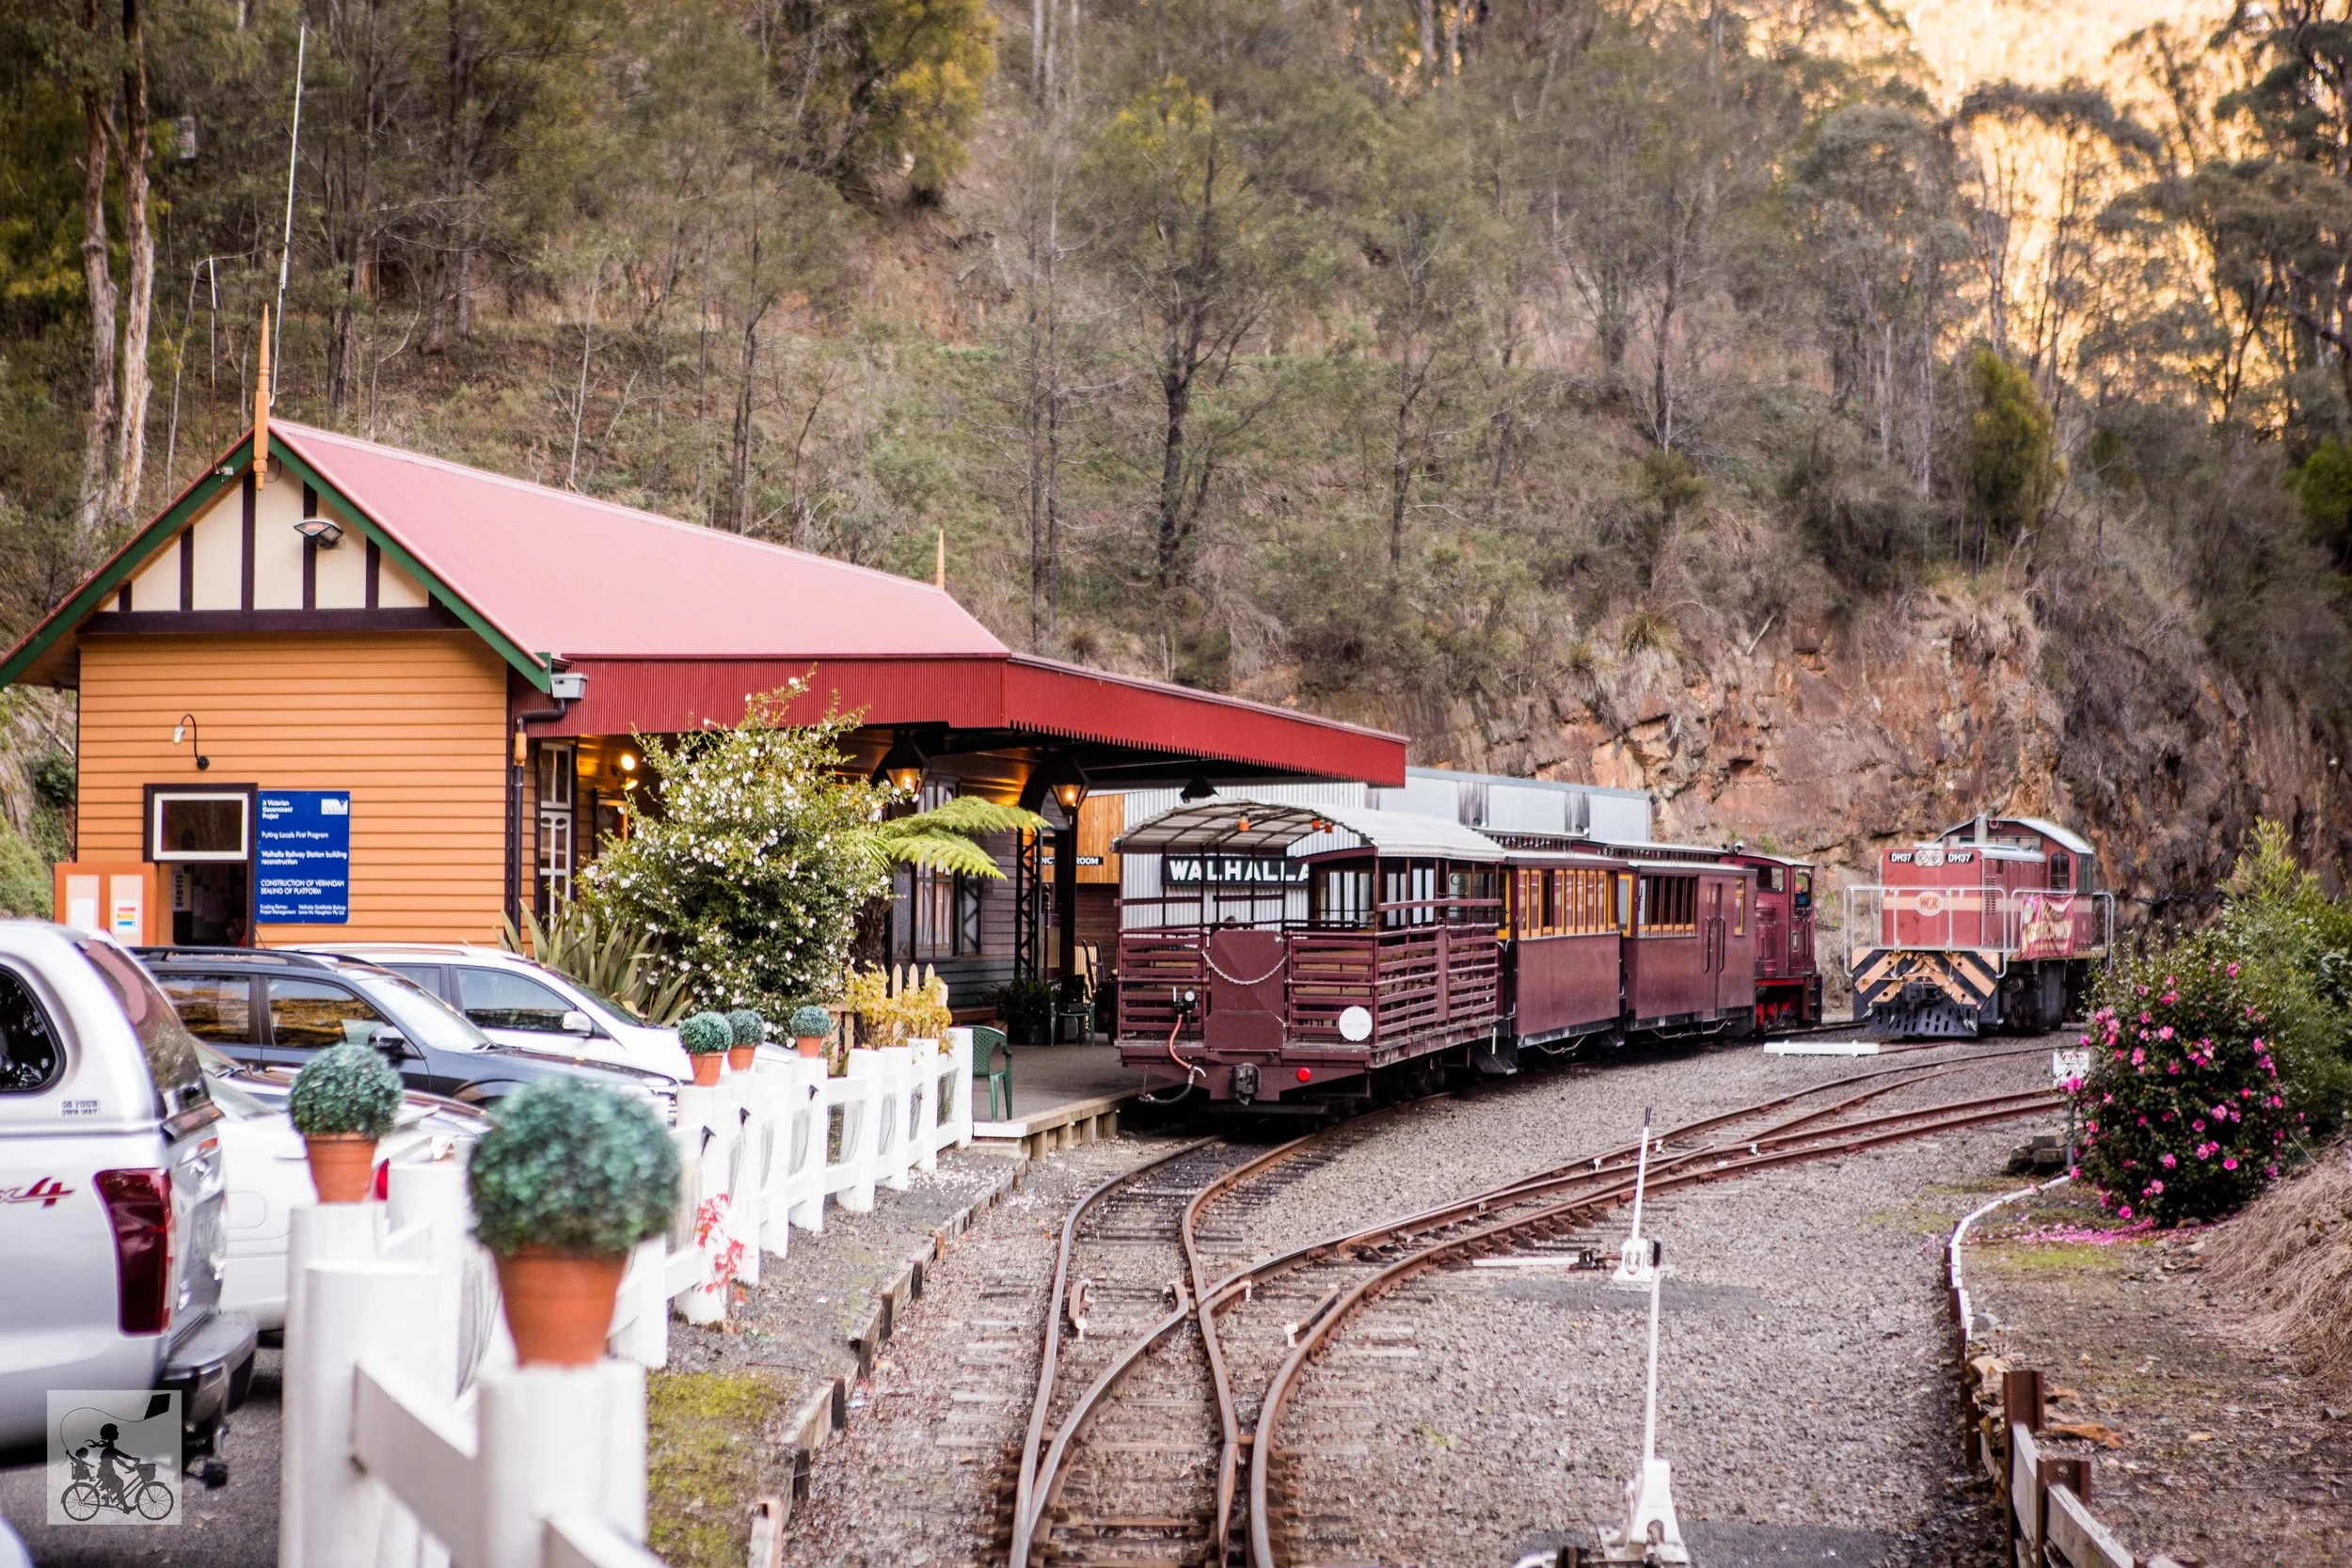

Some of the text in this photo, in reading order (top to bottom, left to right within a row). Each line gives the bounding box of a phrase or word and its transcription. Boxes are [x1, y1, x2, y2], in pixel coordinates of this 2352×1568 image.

[307, 832, 329, 840] Program
[285, 850, 306, 860] Railway
[306, 850, 326, 859] Station
[326, 850, 348, 860] building
[1891, 853, 1913, 863] DH37
[1947, 853, 1972, 863] DH37
